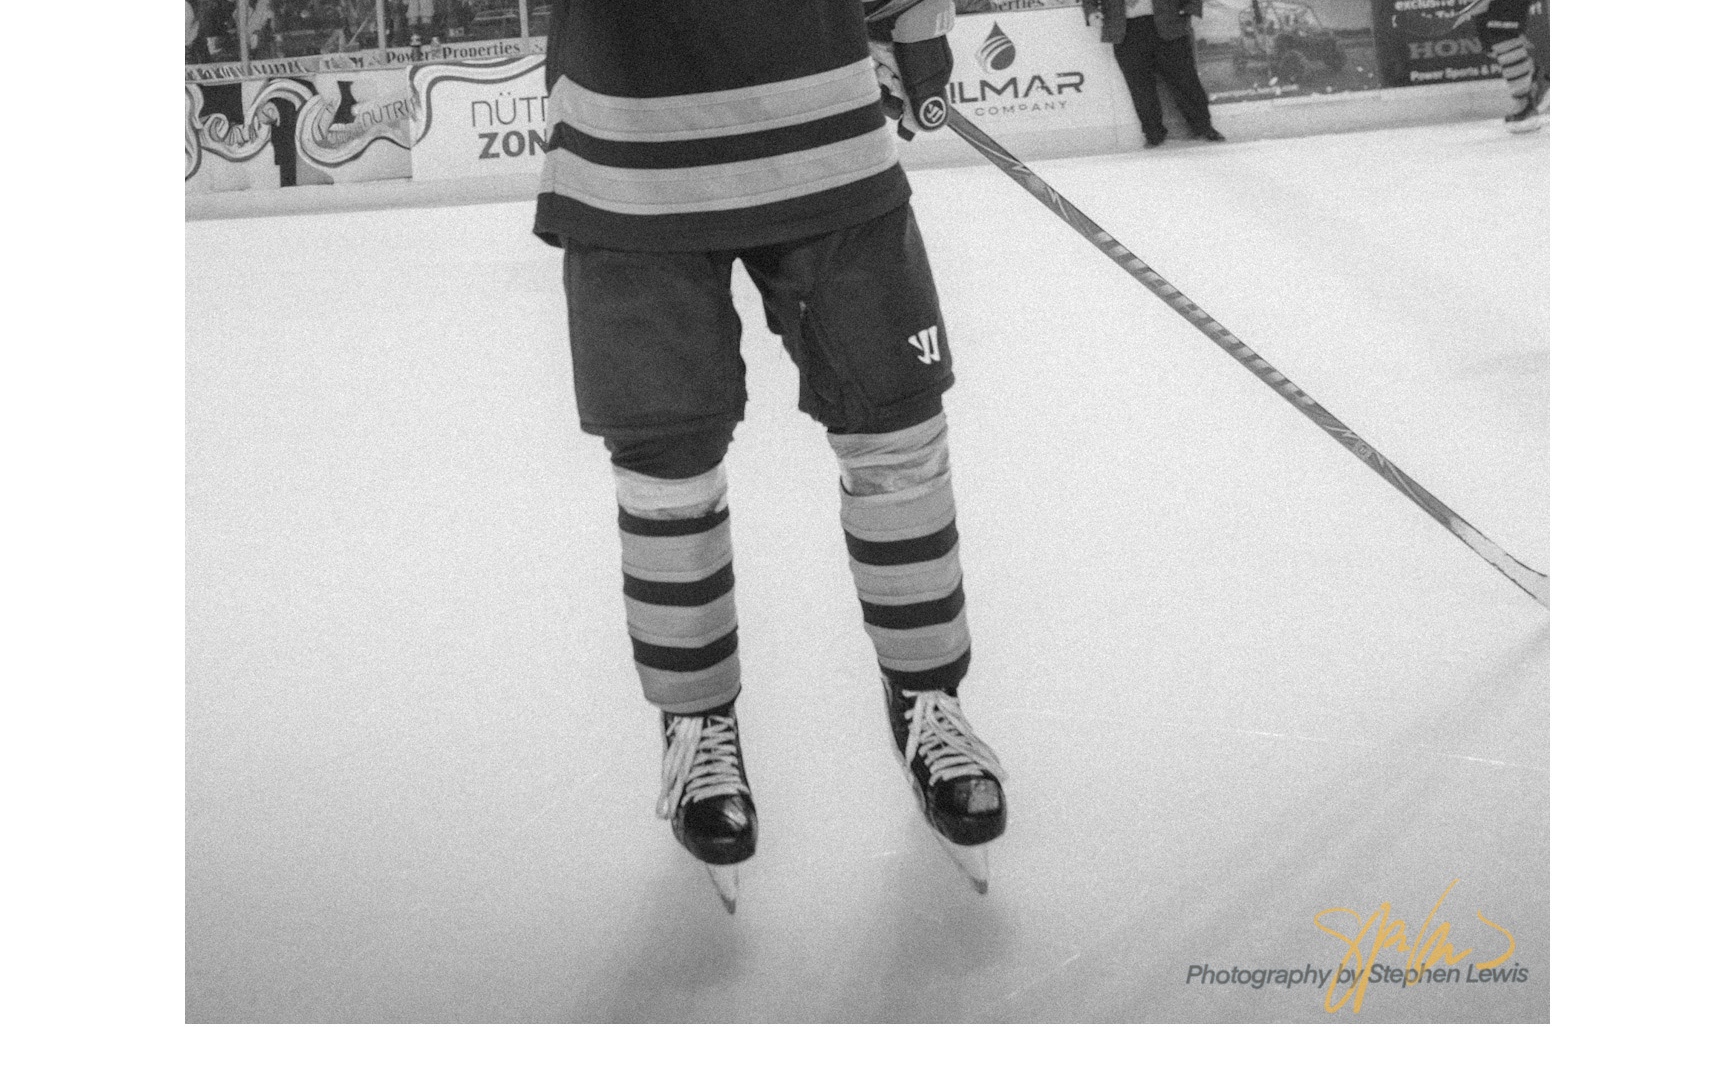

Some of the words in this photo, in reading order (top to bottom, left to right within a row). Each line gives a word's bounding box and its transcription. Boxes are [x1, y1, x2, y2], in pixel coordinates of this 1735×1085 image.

[442, 41, 521, 60] Properties
[1408, 37, 1483, 60] HON
[949, 71, 1085, 104] ILMAR
[974, 101, 1068, 116] COMPANY
[478, 128, 549, 160] ZON
